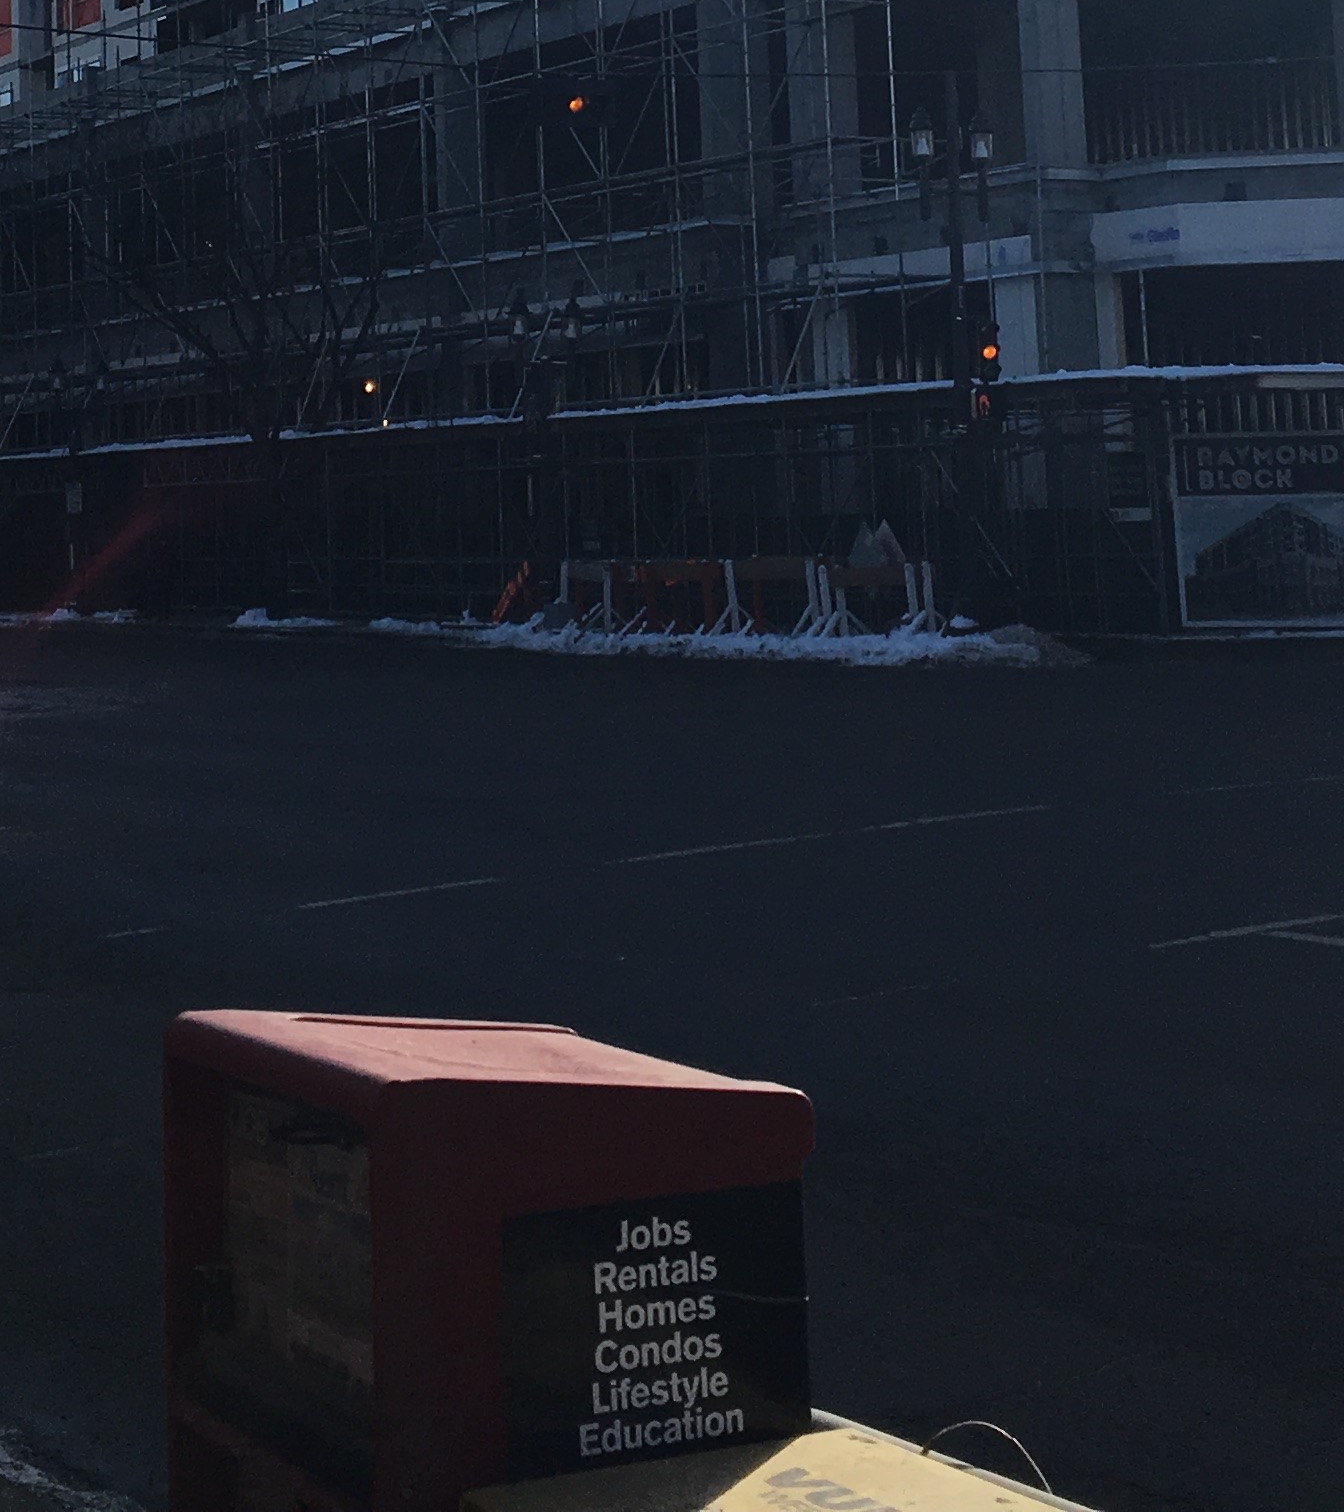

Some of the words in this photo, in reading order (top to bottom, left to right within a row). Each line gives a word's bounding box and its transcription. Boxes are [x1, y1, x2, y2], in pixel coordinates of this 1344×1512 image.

[1197, 444, 1339, 466] RAYMOND
[1199, 468, 1293, 490] BLOCK
[616, 1216, 692, 1252] Jobs
[594, 1250, 718, 1294] Rentals
[598, 1294, 717, 1334] Homes
[594, 1331, 723, 1374] Condos
[592, 1366, 729, 1414] Lifestyle
[579, 1406, 744, 1457] Education
